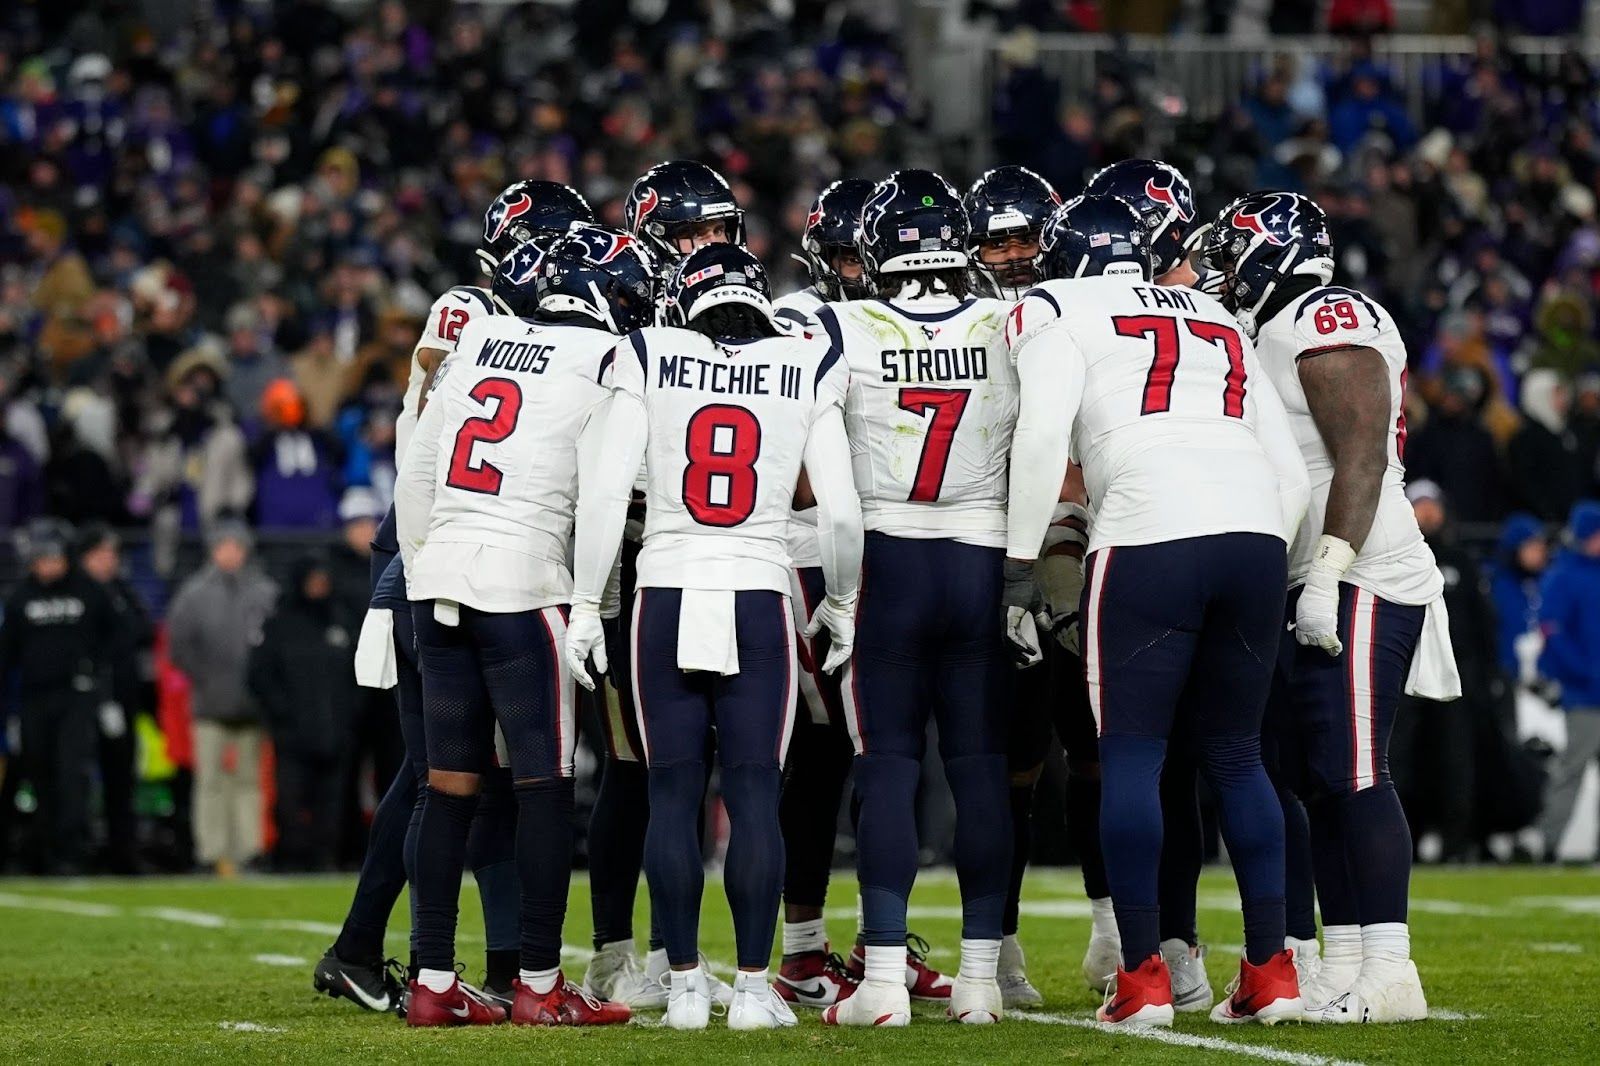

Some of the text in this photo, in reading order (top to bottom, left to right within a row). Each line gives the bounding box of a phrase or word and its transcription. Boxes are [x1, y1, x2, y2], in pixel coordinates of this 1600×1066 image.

[902, 257, 956, 267] TEXANS
[711, 290, 764, 304] TEXANS
[1132, 286, 1198, 314] FANT
[438, 306, 470, 342] 12
[1314, 301, 1360, 335] 69
[475, 338, 556, 375] WOODS
[881, 347, 988, 382] STROUD
[1110, 314, 1248, 420] 77
[658, 355, 802, 400] METCHIE III
[445, 376, 523, 496] 2
[898, 387, 972, 502] 7
[682, 403, 762, 528] 8
